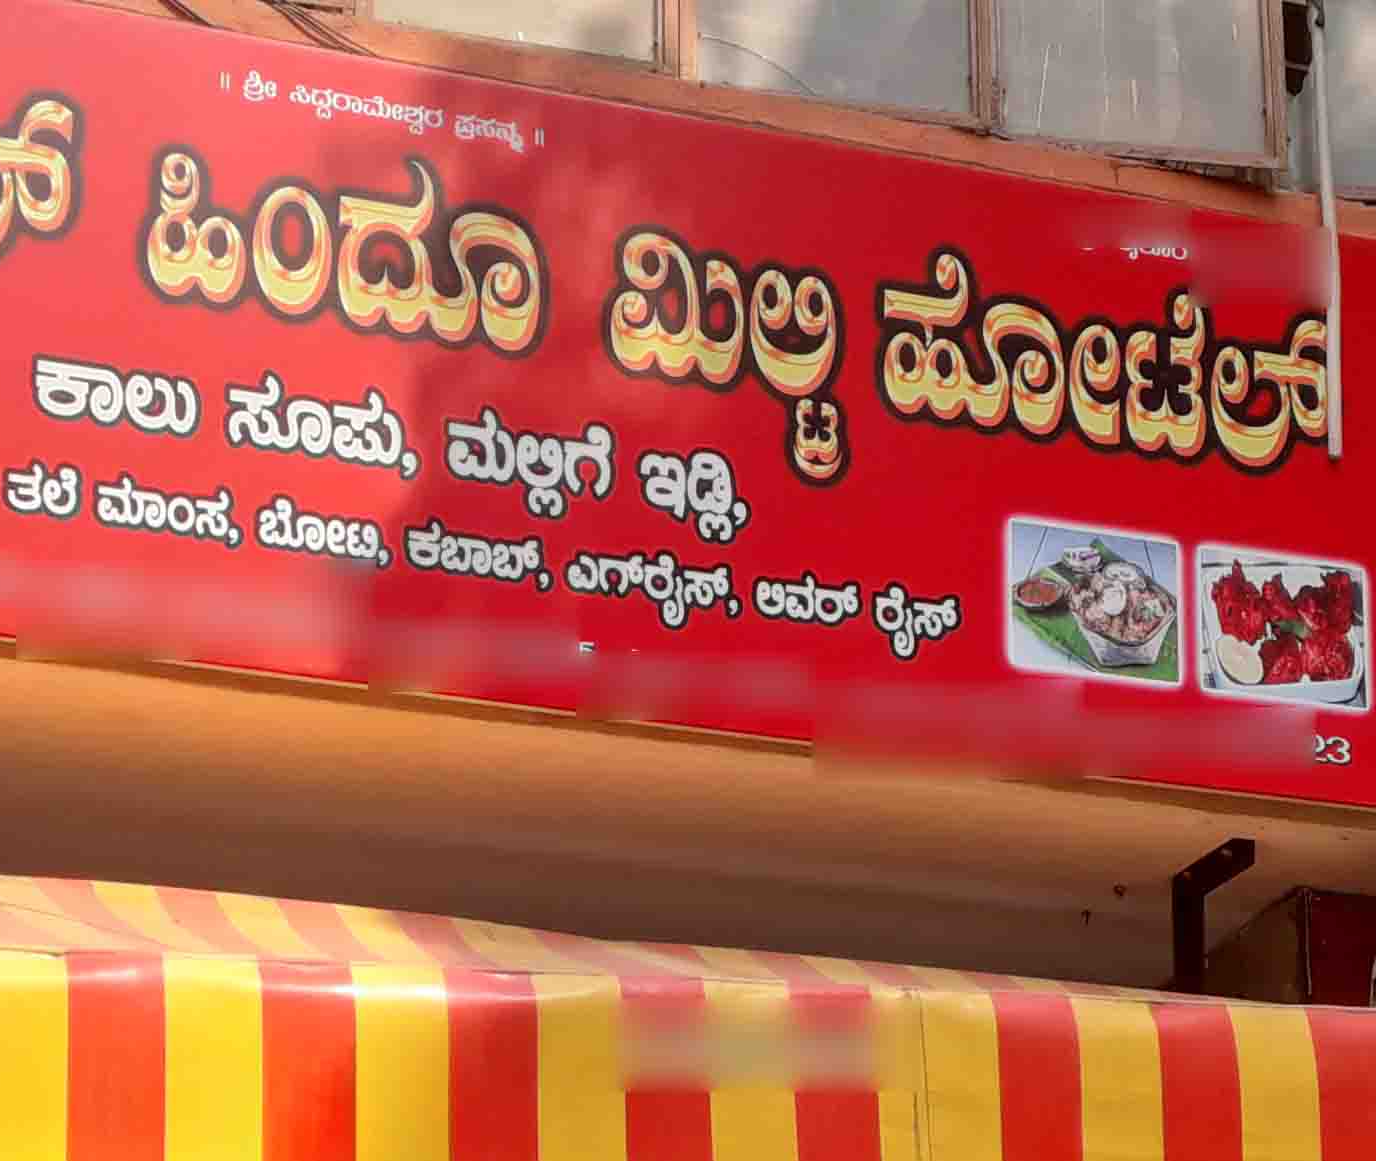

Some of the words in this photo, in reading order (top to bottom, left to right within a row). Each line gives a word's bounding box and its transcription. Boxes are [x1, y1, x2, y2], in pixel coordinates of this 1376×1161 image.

[242, 69, 277, 102] ಶ್ರೀ
[454, 113, 524, 153] ಪ್ರಸನ್ನ
[147, 152, 540, 352] ಹಿಂದೂ
[882, 252, 1329, 468] ಹೋಟೆಲ್
[35, 358, 199, 435] ಕಾಲು
[227, 375, 419, 477] ಸೂಪು,
[446, 408, 614, 519] ಮಲ್ಲಿಗೆ
[639, 450, 750, 543] ಇಡ್ಲಿ,
[6, 465, 80, 516] ತಲೆ
[97, 478, 242, 545] ಮಾಂಸ,
[257, 498, 391, 566] ಬೋಟಿ,
[407, 520, 551, 589] ಕಬಾಬ್,
[755, 575, 860, 624] ಲಿವರ್
[875, 585, 958, 658] ರೈಸ್
